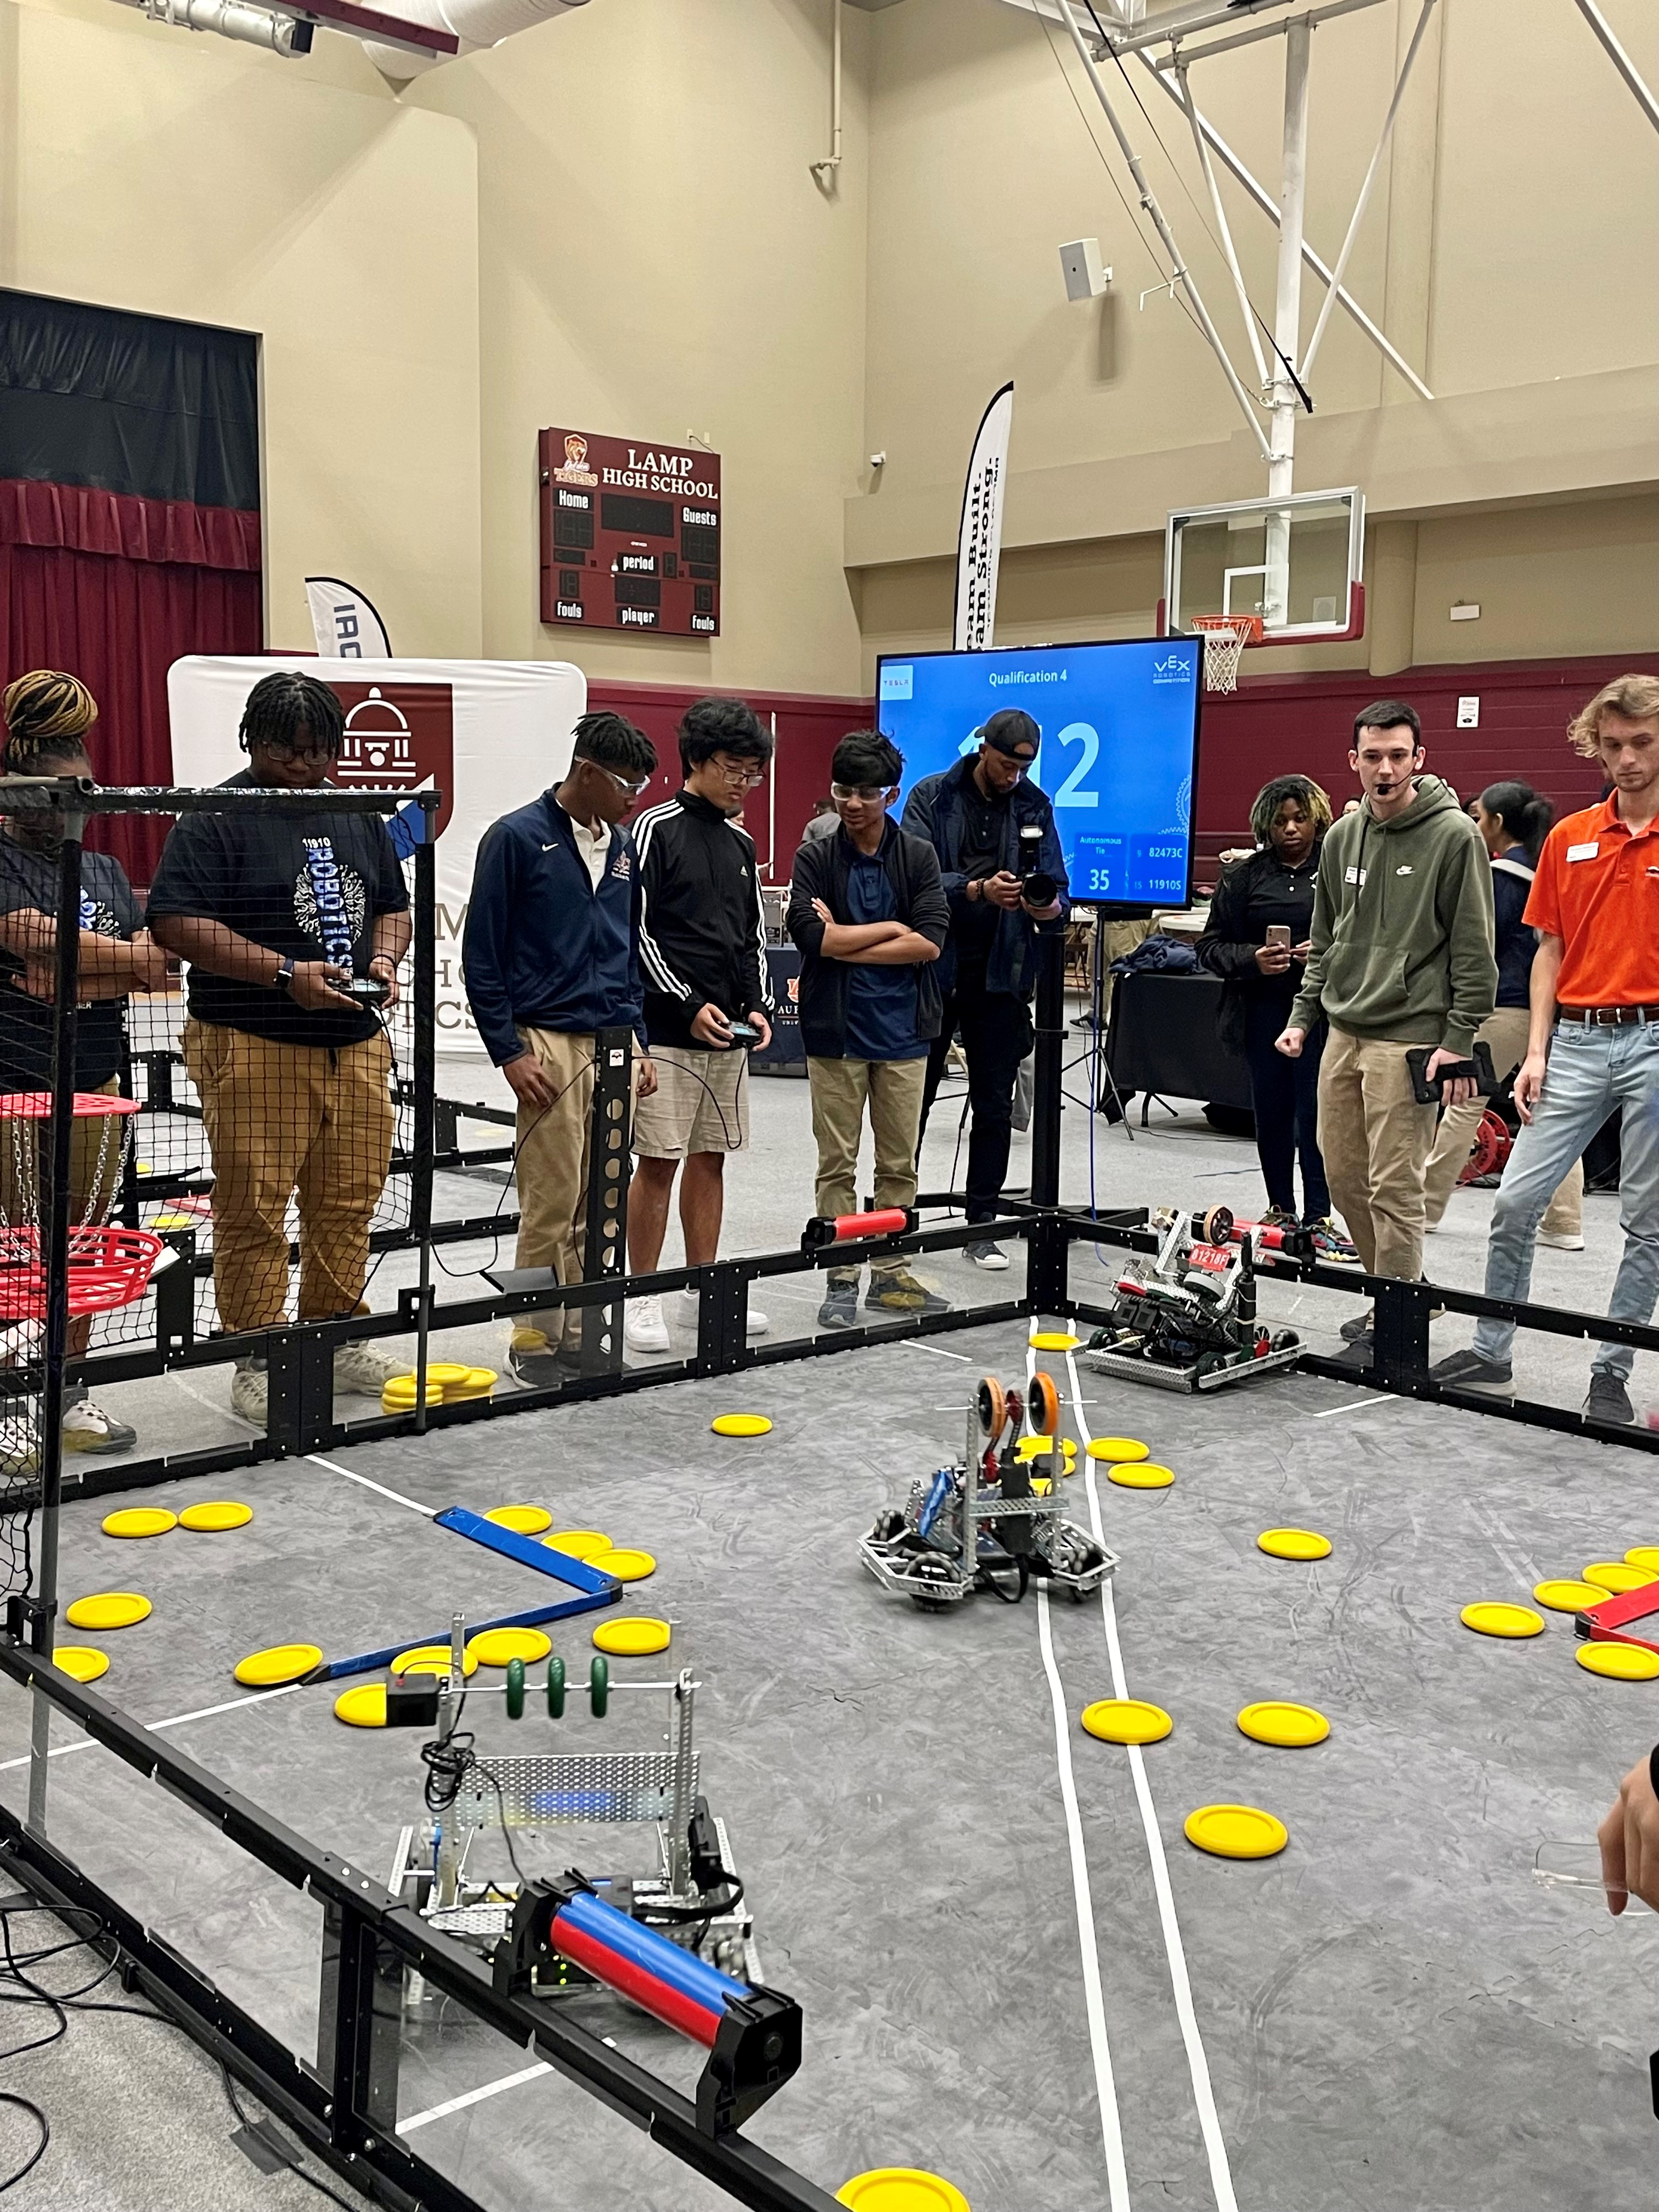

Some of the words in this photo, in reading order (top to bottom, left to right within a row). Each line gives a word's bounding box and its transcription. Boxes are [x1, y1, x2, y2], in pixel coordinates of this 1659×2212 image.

[628, 449, 693, 477] LAMP
[554, 467, 598, 487] TIGERS
[602, 467, 647, 489] HIGH
[651, 475, 718, 499] SCHOOL
[559, 489, 588, 509] Home
[683, 507, 716, 526] Guests
[969, 472, 981, 567] Built.
[977, 458, 992, 579] Strong.
[623, 556, 654, 571] period
[557, 601, 582, 618] fouls
[622, 607, 654, 625] player
[967, 577, 975, 650] eam
[692, 615, 714, 630] fouls
[976, 589, 986, 650] am
[989, 670, 1058, 687] Qualification
[1060, 669, 1067, 681] 4
[302, 837, 331, 848] 11910
[1080, 836, 1121, 844] Autonomous
[1149, 848, 1183, 858] 82473C
[1089, 868, 1109, 890] 35
[1149, 879, 1181, 890] 11910S
[308, 848, 354, 967] ROBOTICS
